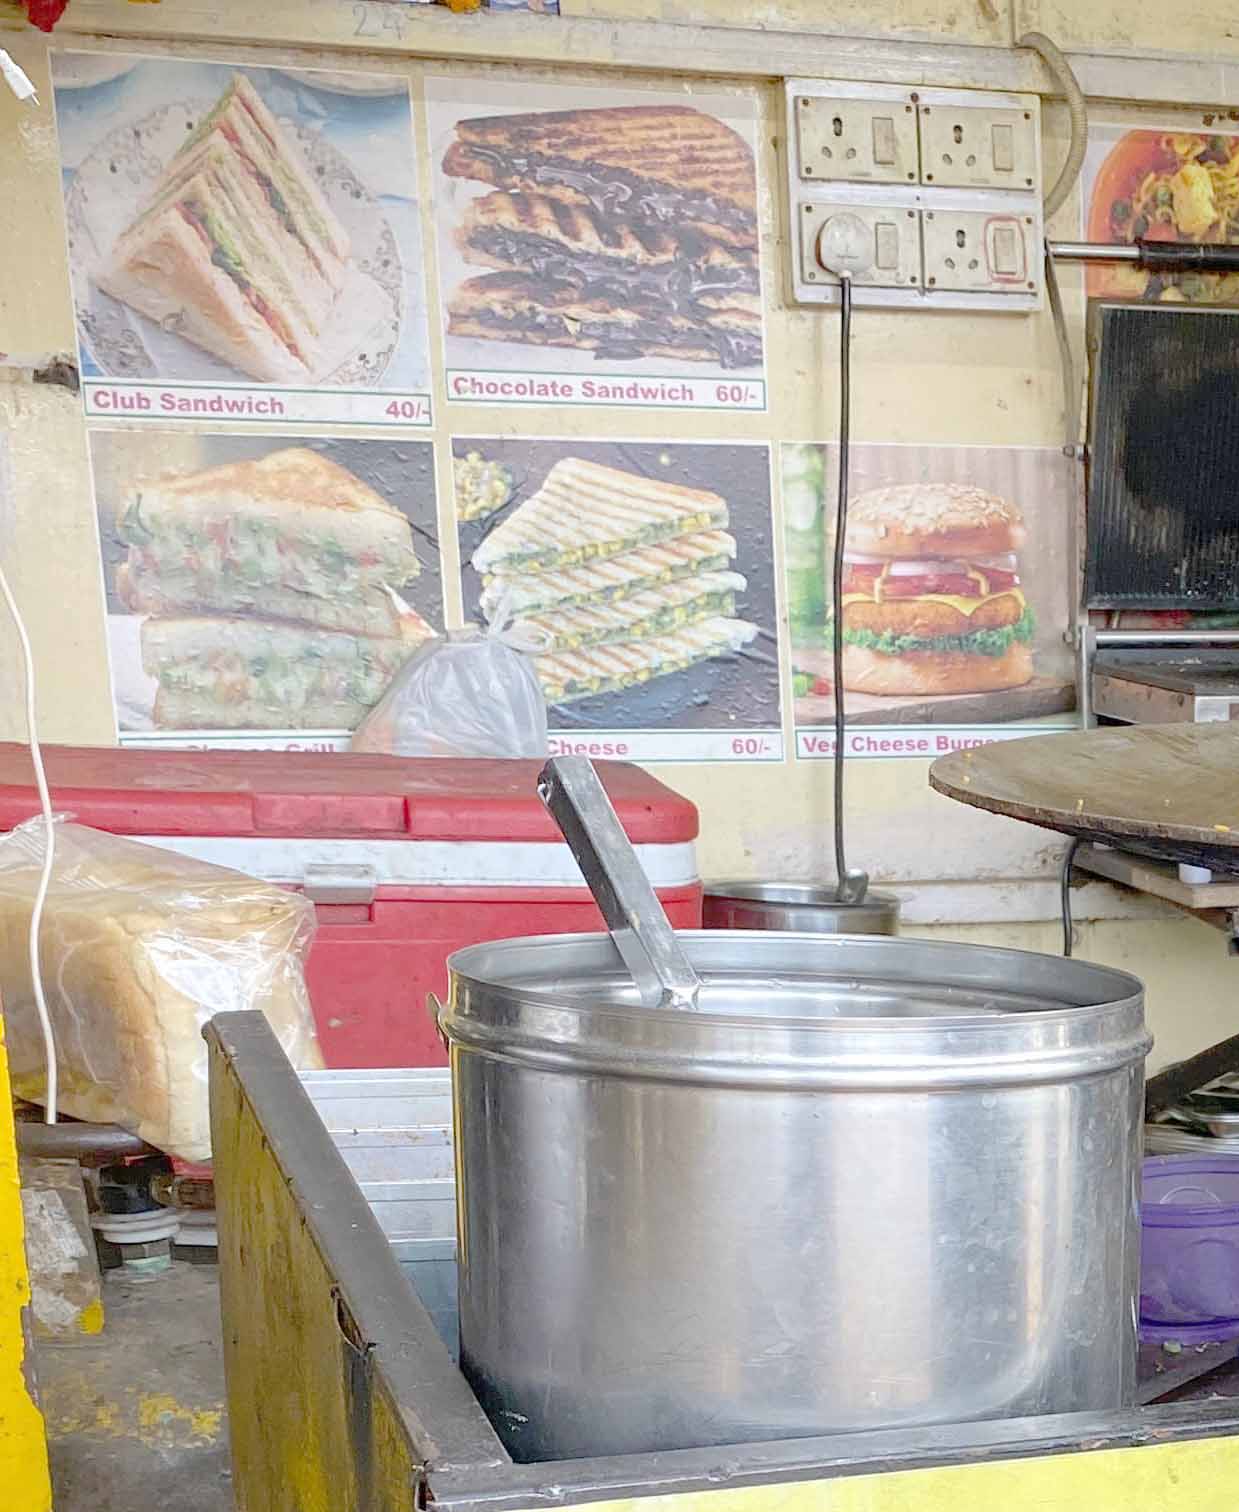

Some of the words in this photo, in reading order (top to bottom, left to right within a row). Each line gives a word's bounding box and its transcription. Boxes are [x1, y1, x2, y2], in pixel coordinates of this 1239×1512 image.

[453, 376, 573, 398] Chocolate
[582, 380, 694, 402] Sandwich
[716, 385, 757, 403] 60/-
[93, 390, 151, 410] Club
[160, 393, 284, 415] Sandwich
[385, 400, 431, 419] 40/-
[547, 739, 629, 756] Cheese
[732, 738, 771, 755] 60/-
[851, 736, 929, 753] Cheese
